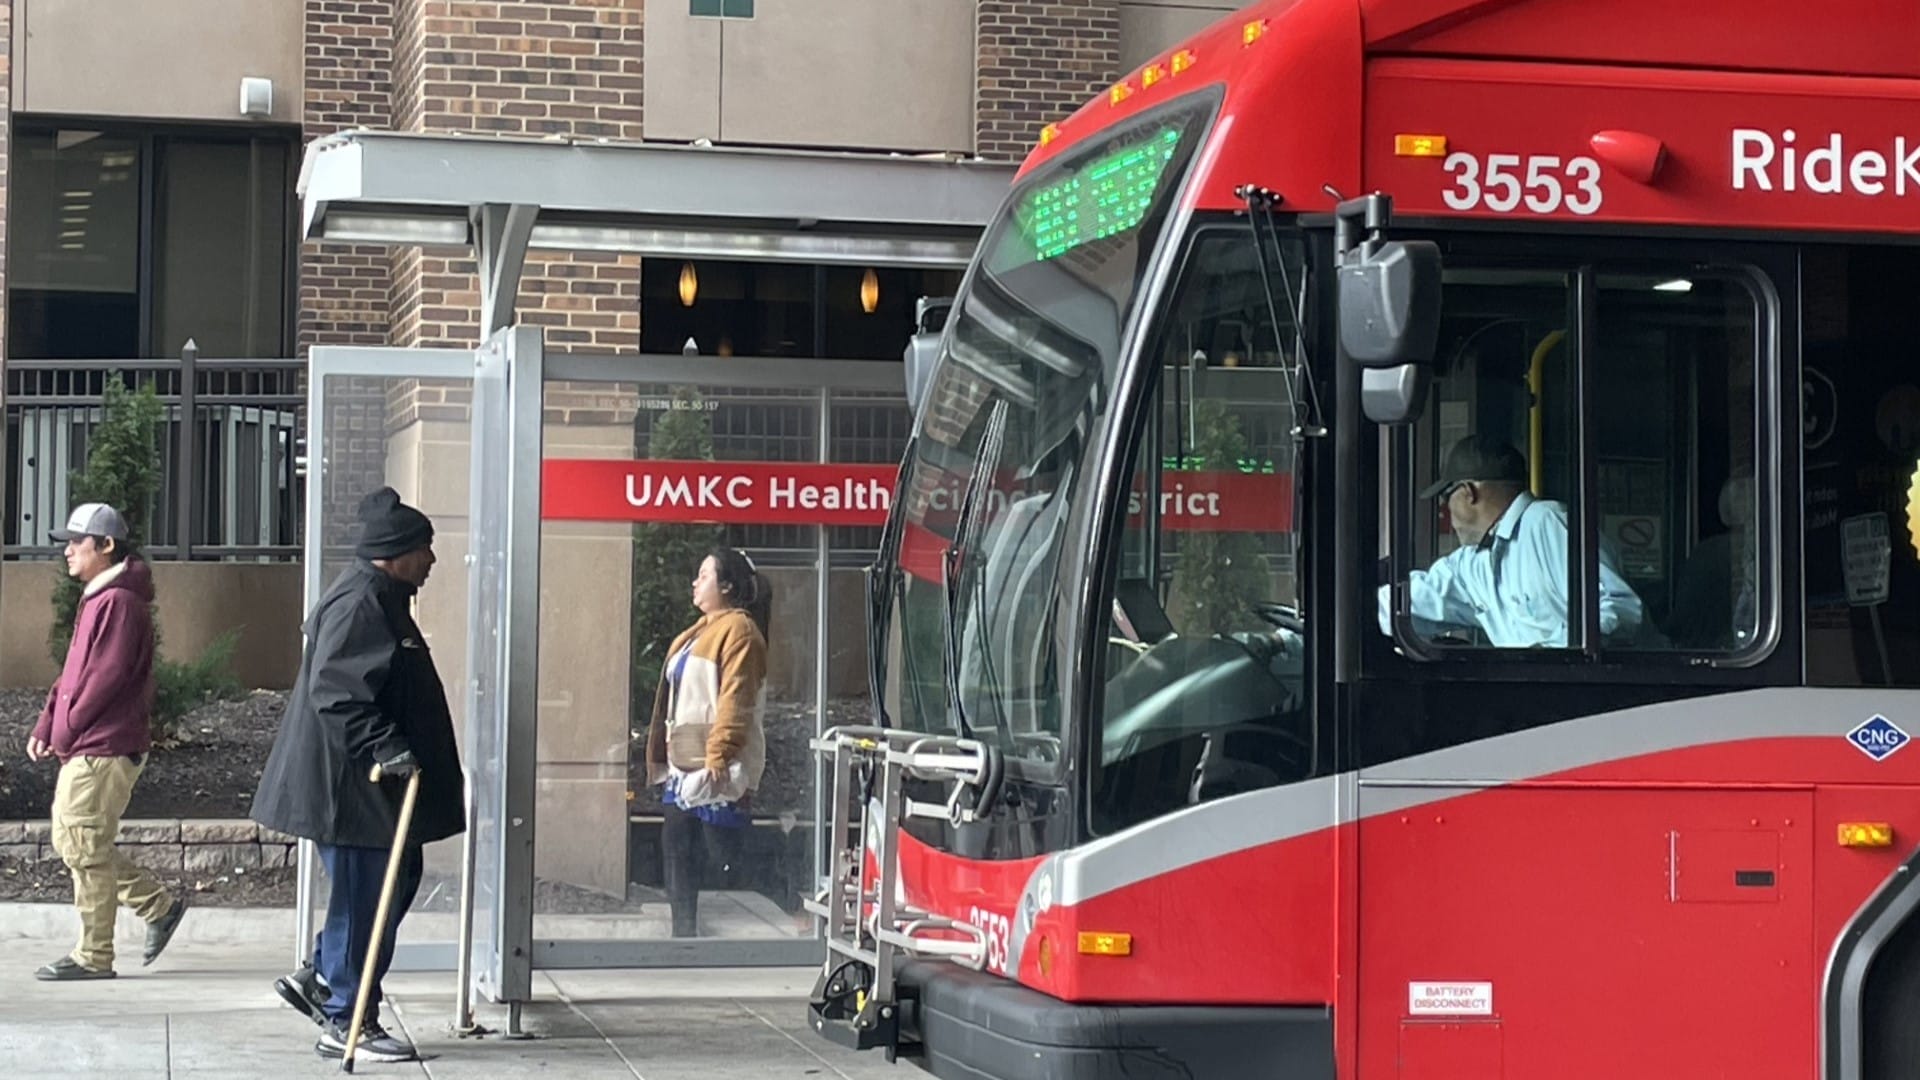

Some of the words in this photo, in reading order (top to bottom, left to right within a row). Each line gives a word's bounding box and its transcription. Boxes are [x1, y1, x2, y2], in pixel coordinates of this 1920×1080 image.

[1731, 128, 1920, 197] RideK
[1442, 152, 1603, 216] 3553
[625, 474, 753, 507] UMKC
[769, 476, 890, 510] Health
[1857, 728, 1899, 745] CNG
[1414, 998, 1487, 1009] DISCONNECT
[1425, 986, 1475, 997] BATTERY
